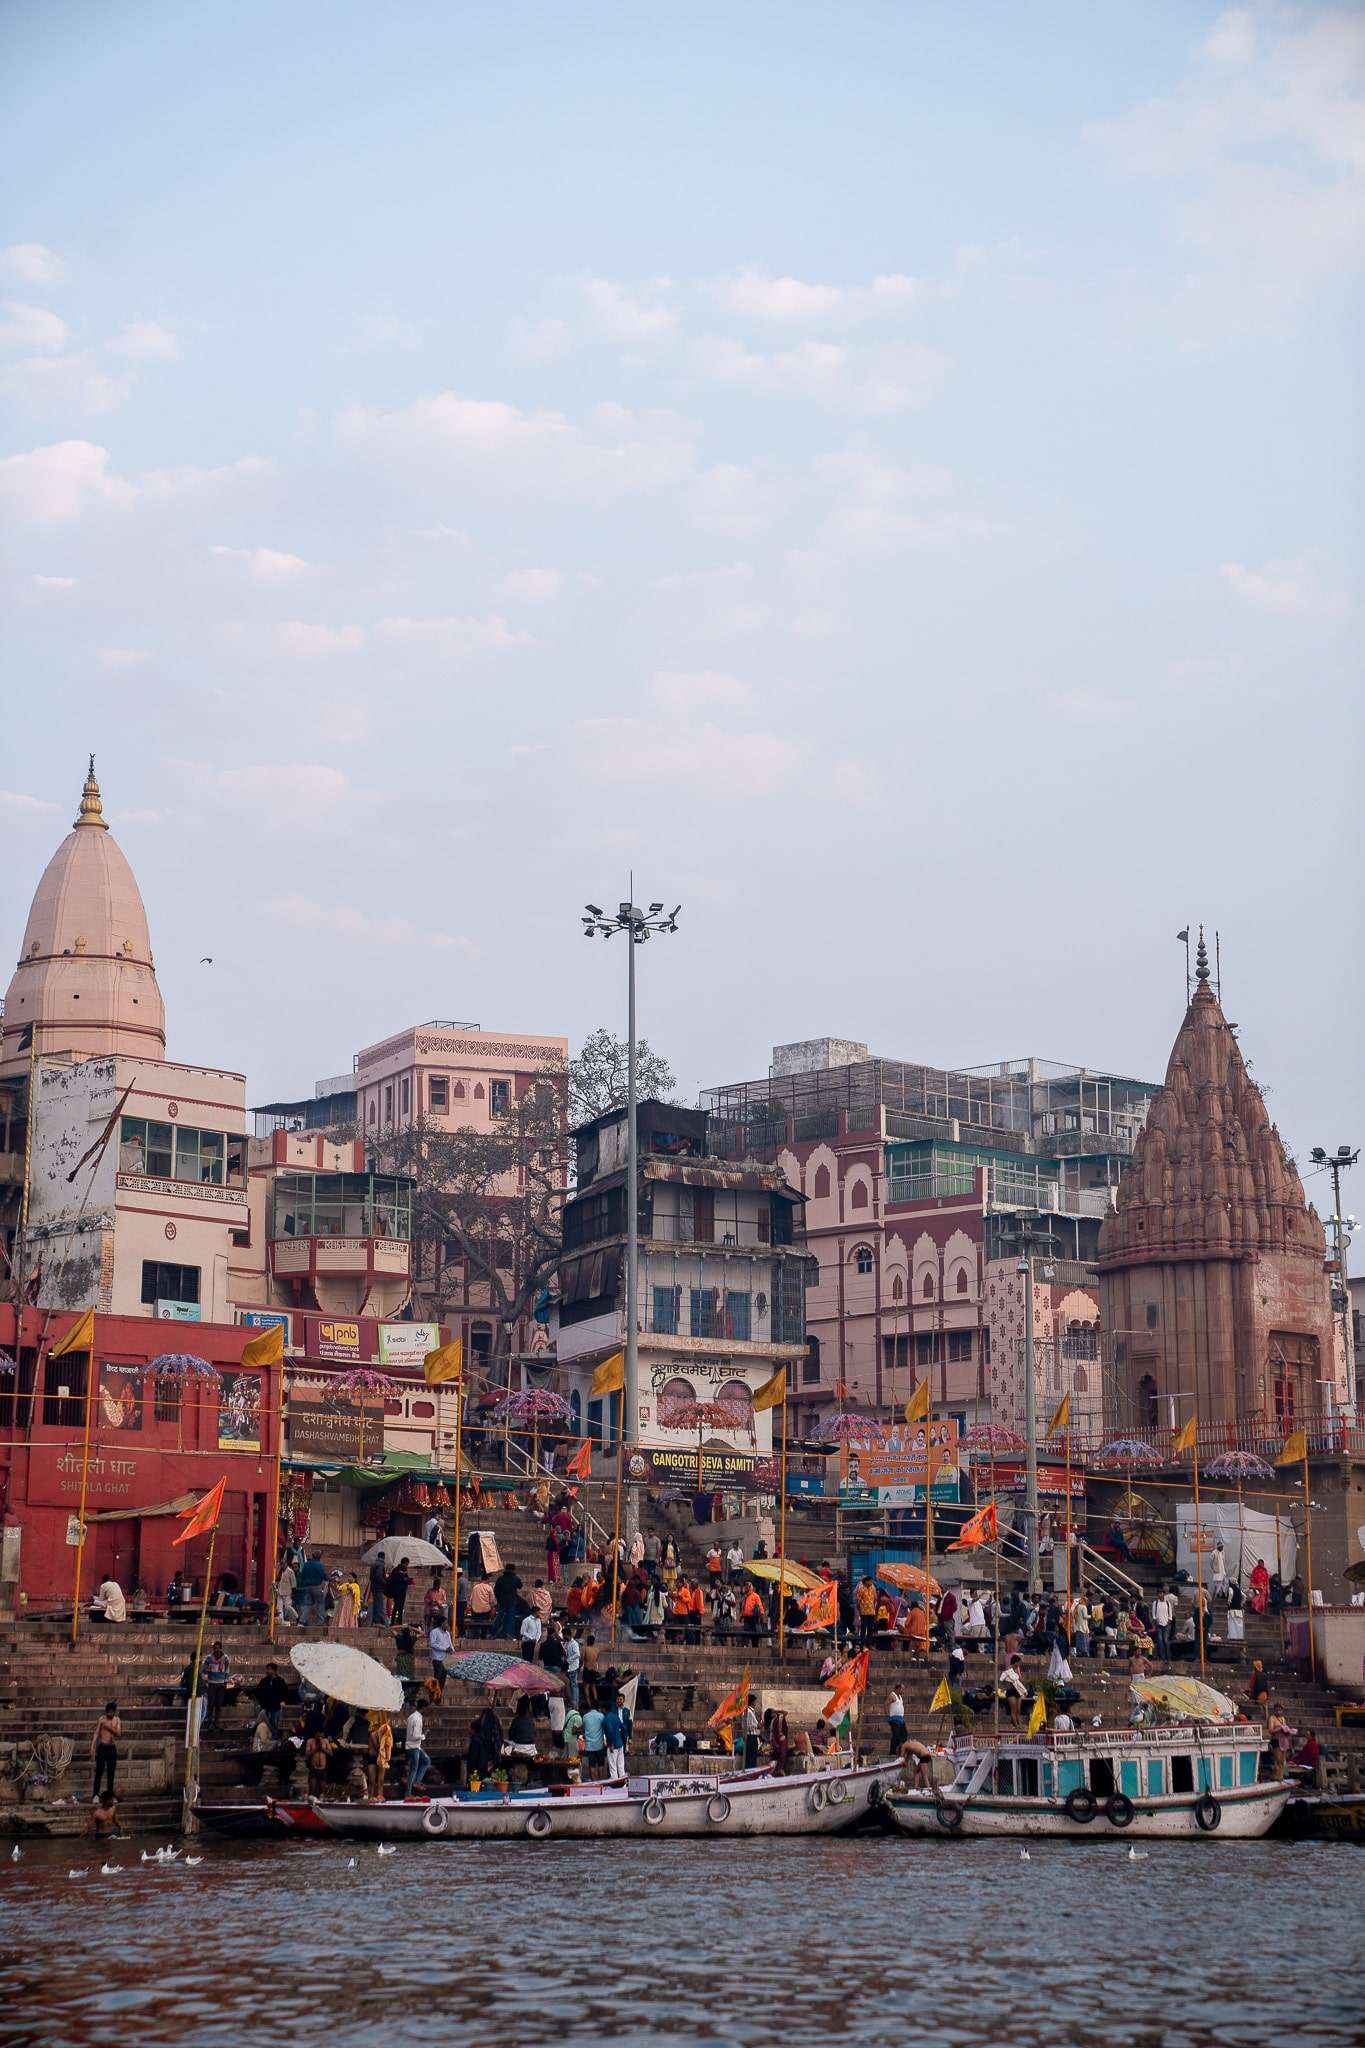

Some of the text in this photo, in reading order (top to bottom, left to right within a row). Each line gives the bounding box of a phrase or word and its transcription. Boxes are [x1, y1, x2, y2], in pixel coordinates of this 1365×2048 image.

[336, 1326, 357, 1342] pnb
[650, 1363, 748, 1379] दशाश्वमेध घाट
[294, 1429, 360, 1445] DASHASHVAMEDH
[110, 1460, 136, 1476] घाट
[652, 1452, 698, 1468] GANGOTRI
[701, 1455, 723, 1470] SEVA
[725, 1457, 755, 1472] SAMITI
[104, 1482, 130, 1494] GHAT
